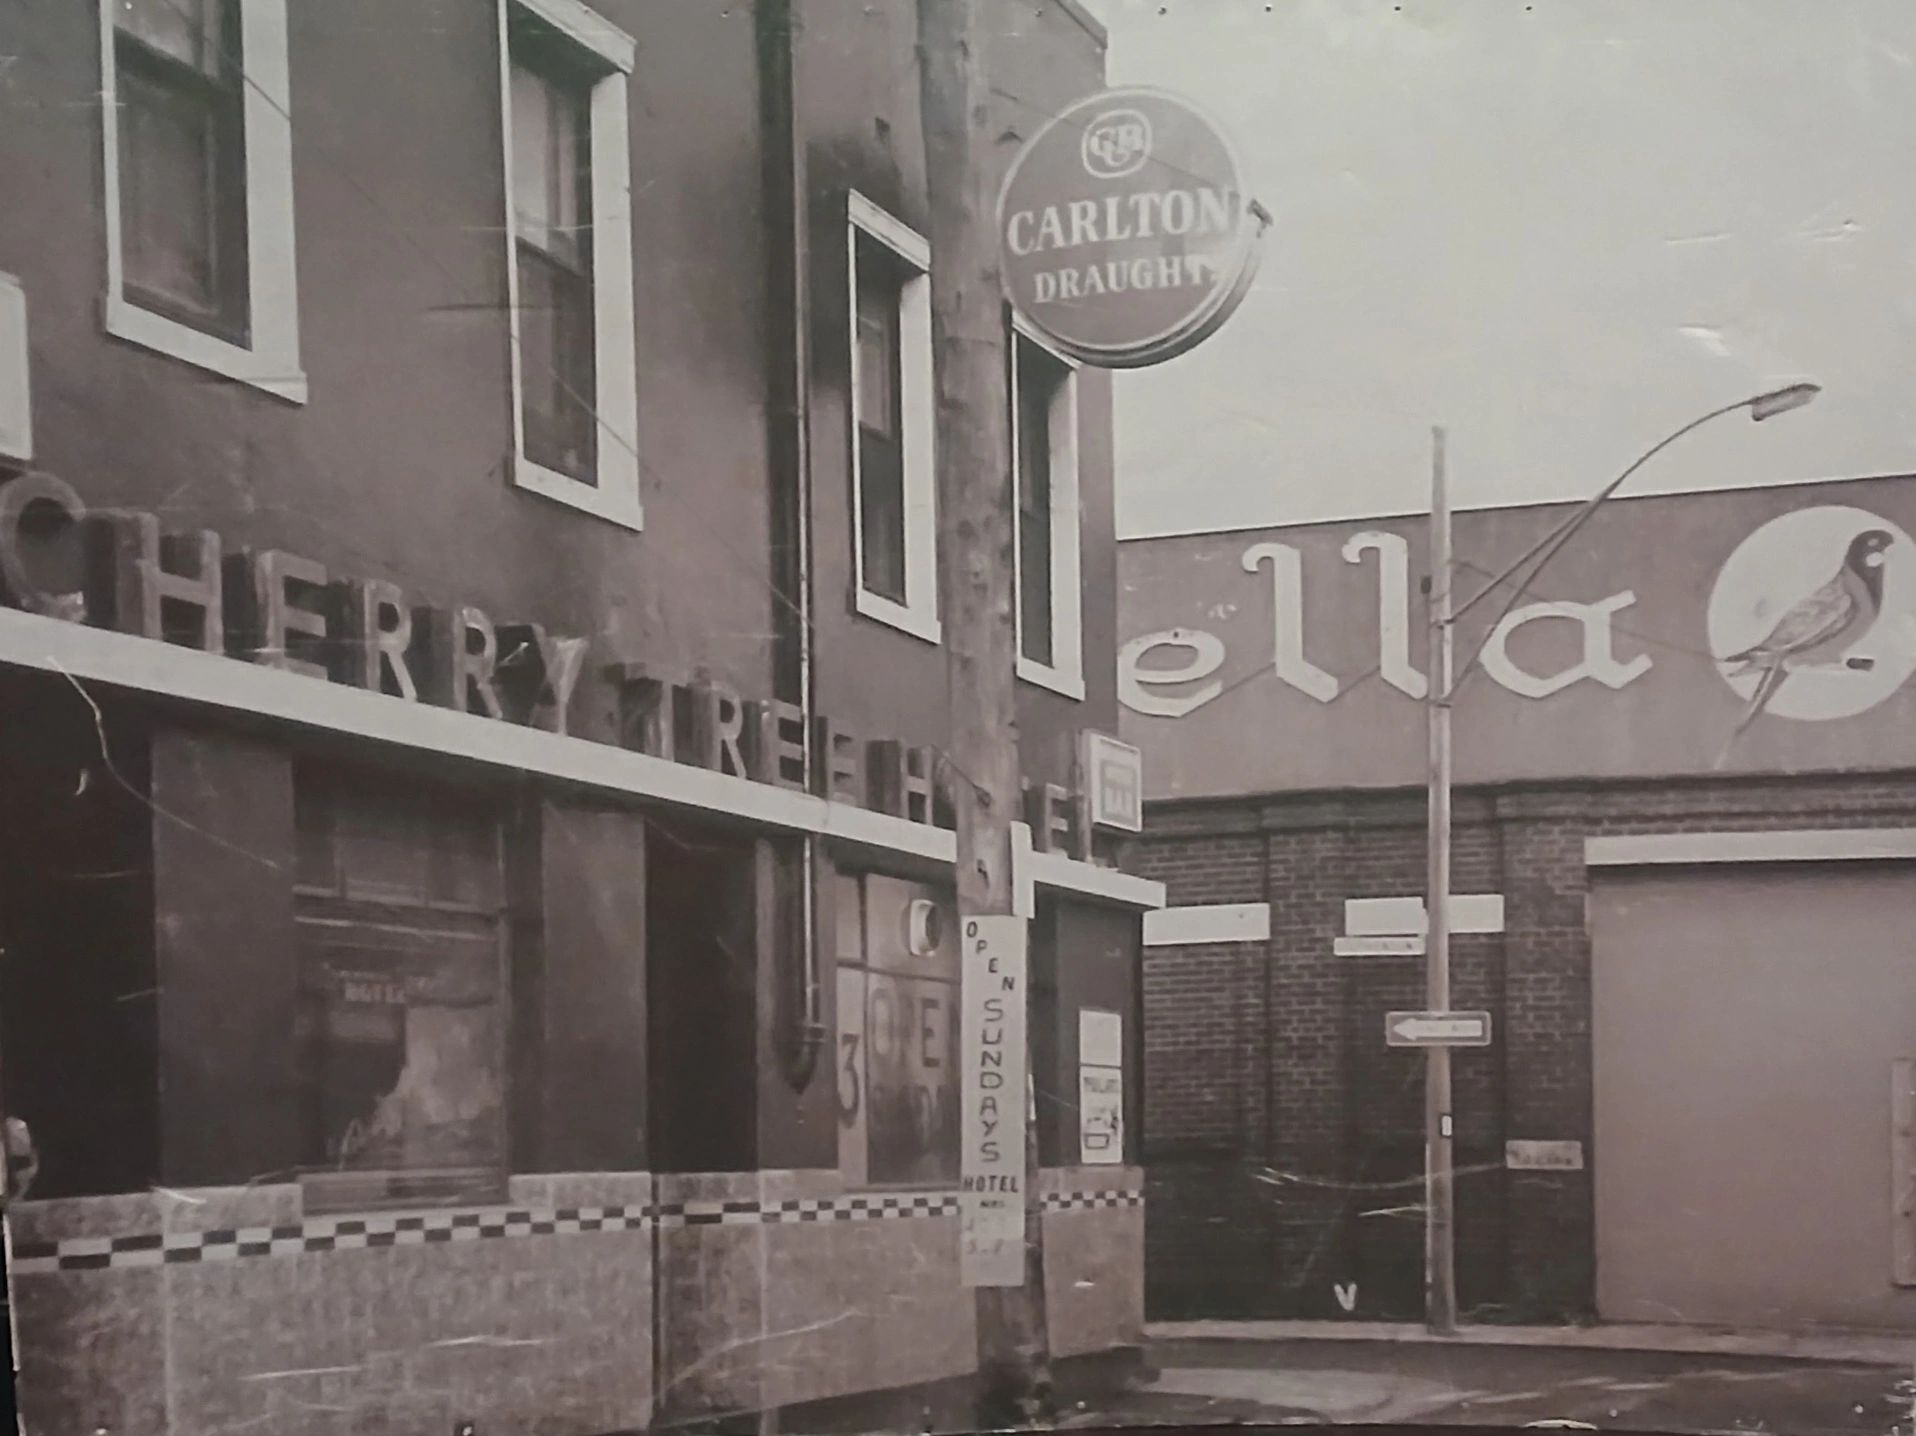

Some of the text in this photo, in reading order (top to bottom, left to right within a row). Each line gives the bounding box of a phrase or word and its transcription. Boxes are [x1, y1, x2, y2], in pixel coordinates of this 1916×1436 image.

[1007, 188, 1229, 255] CARLTON
[1034, 254, 1209, 303] DRAUGHT
[0, 472, 588, 736] CHERRY
[966, 921, 1015, 991] OPEN
[980, 998, 1004, 1163] SUNDAYS
[963, 1175, 1019, 1193] HOTEL
